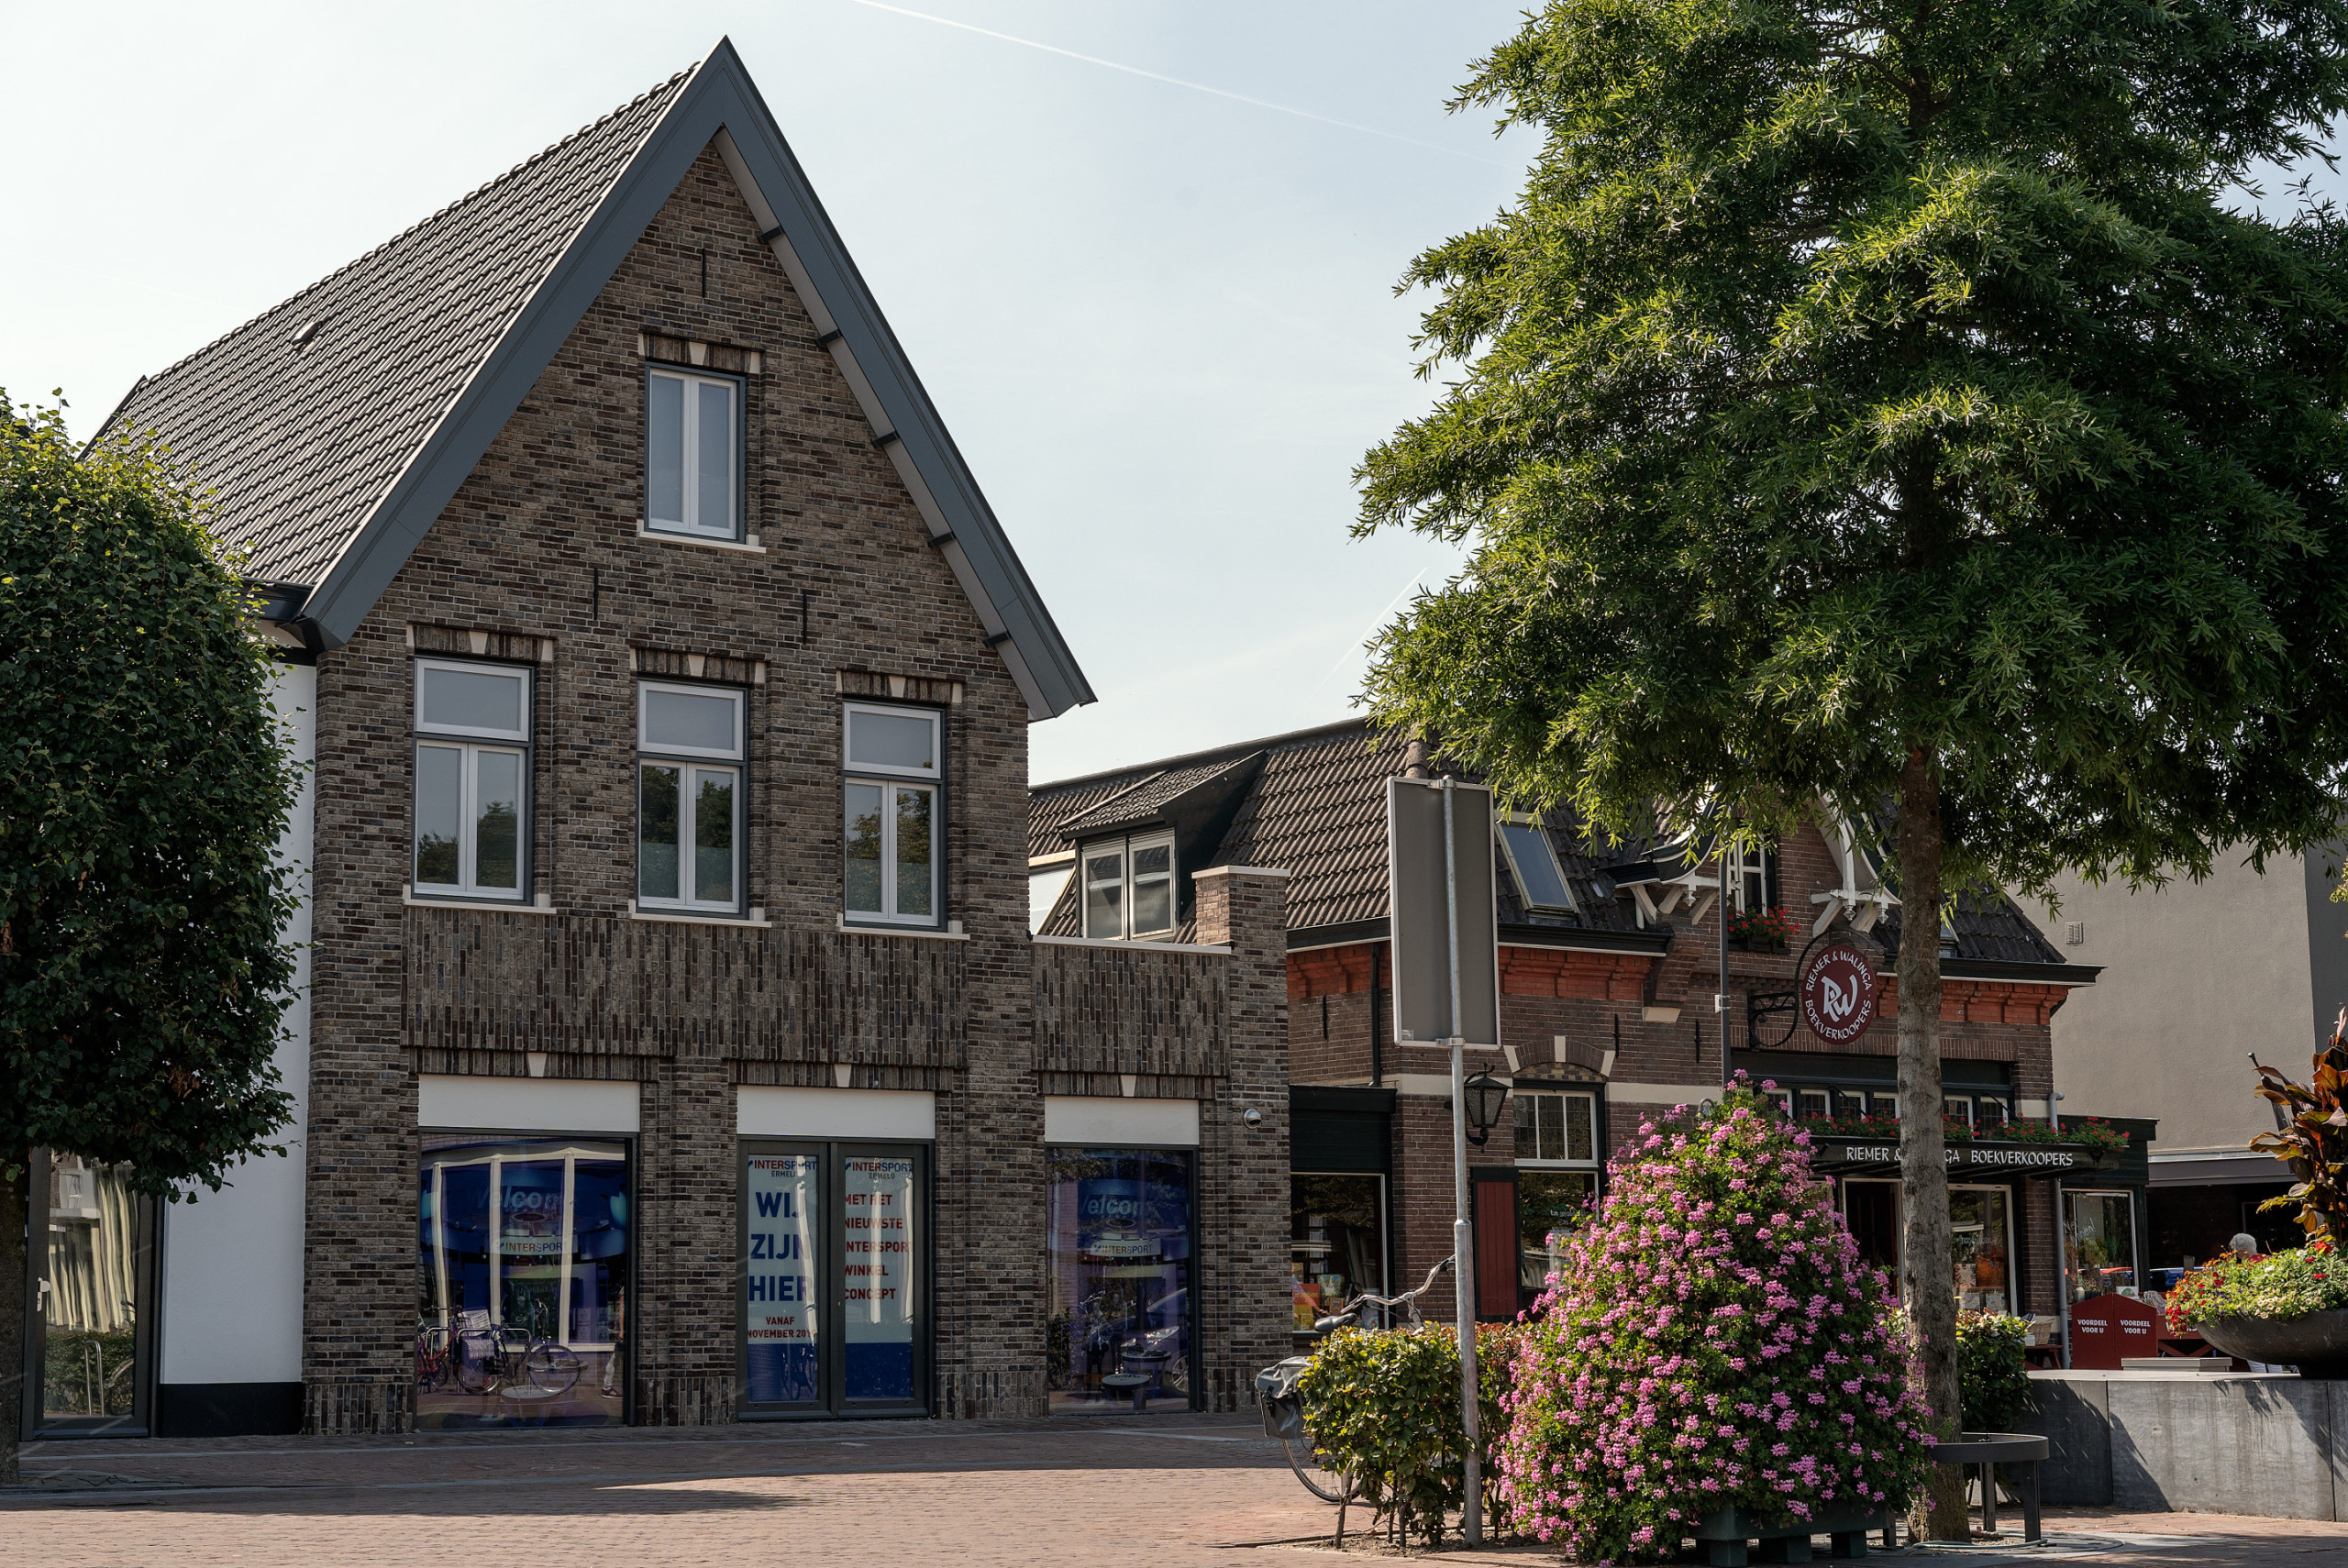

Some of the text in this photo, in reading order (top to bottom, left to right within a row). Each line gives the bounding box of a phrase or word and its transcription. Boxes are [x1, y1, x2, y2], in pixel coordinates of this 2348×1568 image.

[1805, 950, 1873, 991] RIEMER & WALINGA
[1805, 999, 1872, 1040] BOEKVERKOOPERS
[1845, 1146, 1889, 1162] RIEMER
[1893, 1147, 1903, 1161] &
[1970, 1149, 2074, 1166] BOEKVERKOOPERS
[754, 1159, 817, 1170] INTERSPRT
[844, 1193, 893, 1206] MET HET
[844, 1217, 903, 1230] NIEUWSTE
[505, 1242, 563, 1253] INTERSPOR
[846, 1241, 914, 1253] NTERSPORT
[844, 1264, 890, 1276] WINKEL
[844, 1287, 896, 1300] CONCEPT
[765, 1316, 795, 1326] VANAF
[2077, 1319, 2108, 1327] VOORDEEL
[747, 1329, 813, 1339] NOVEMBER 201
